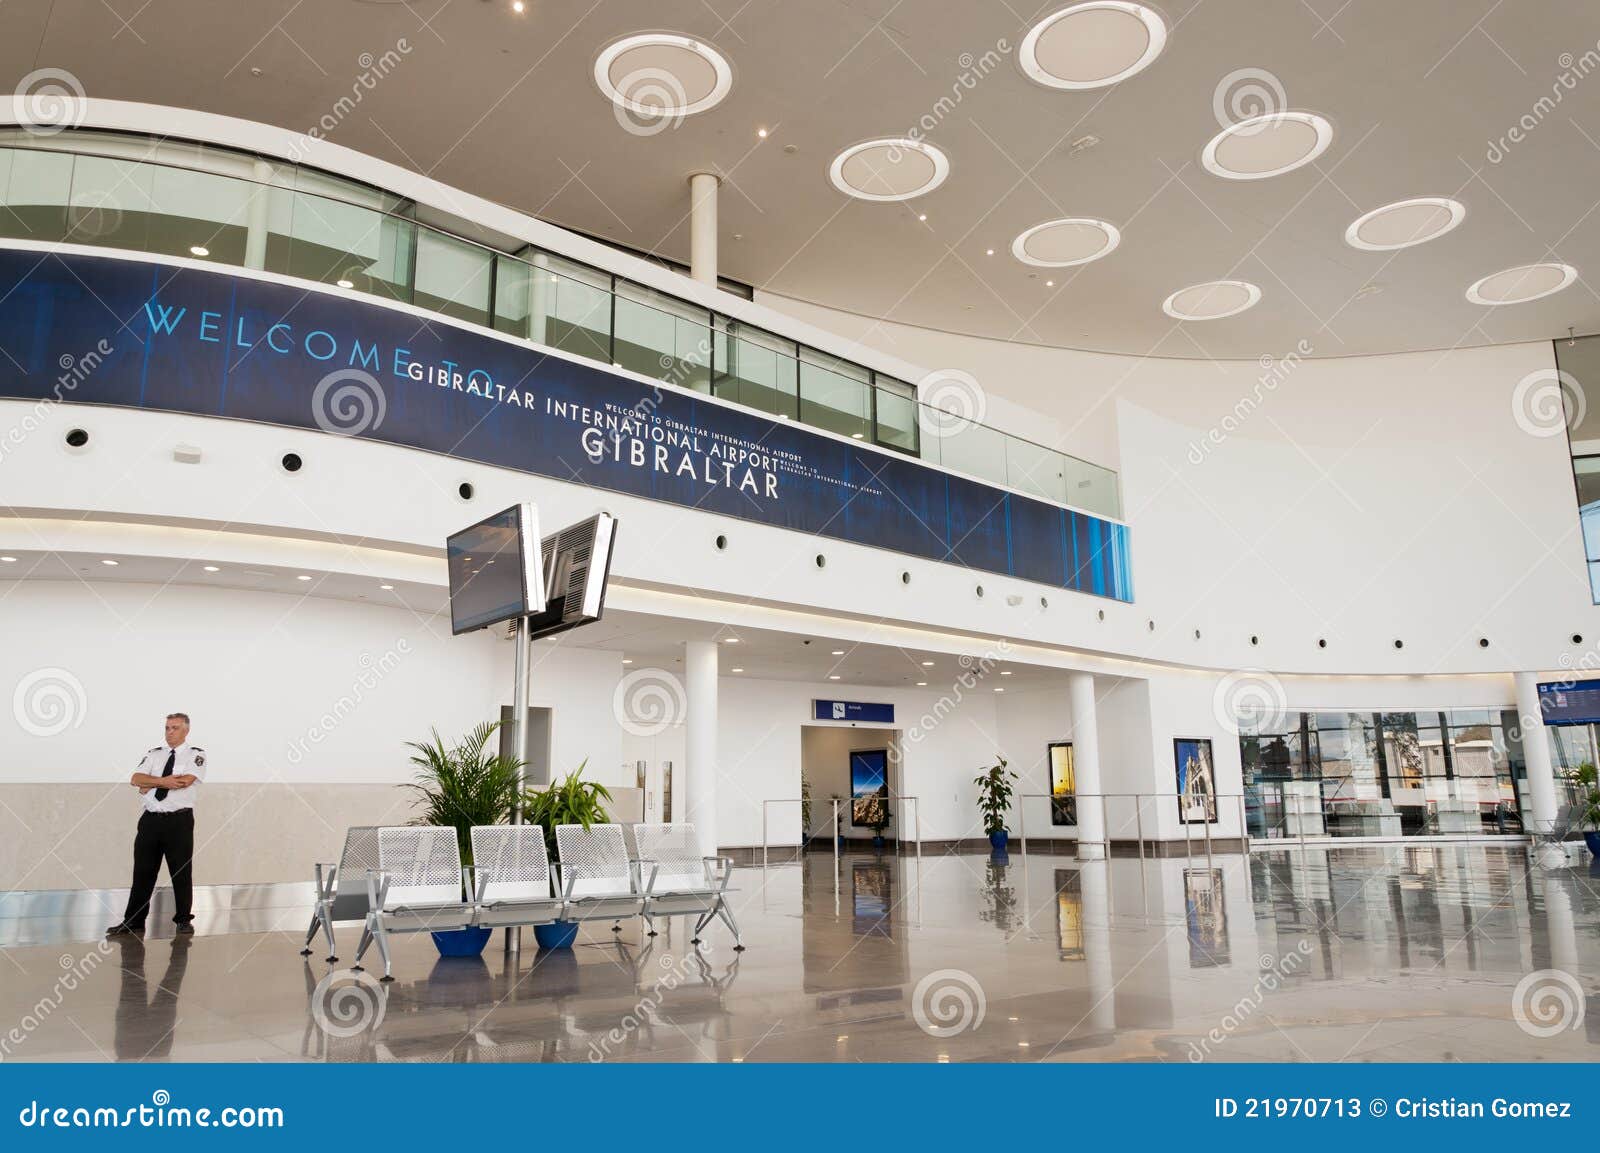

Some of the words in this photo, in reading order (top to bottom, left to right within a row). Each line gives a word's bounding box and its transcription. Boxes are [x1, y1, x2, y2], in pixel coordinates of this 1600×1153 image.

[144, 302, 411, 378] WELCOME
[442, 360, 493, 397] TO
[407, 362, 535, 410] GIBRALTAR
[546, 398, 701, 453] INTERNATIONAL
[710, 442, 779, 473] AIRPORT
[605, 403, 647, 421] WELCOME
[651, 415, 662, 425] TO
[665, 420, 708, 437] GIBRALTAR
[711, 432, 770, 455] INTERNATIONAL
[772, 450, 802, 462] AIRPORT
[581, 427, 779, 499] GIBRALTAR
